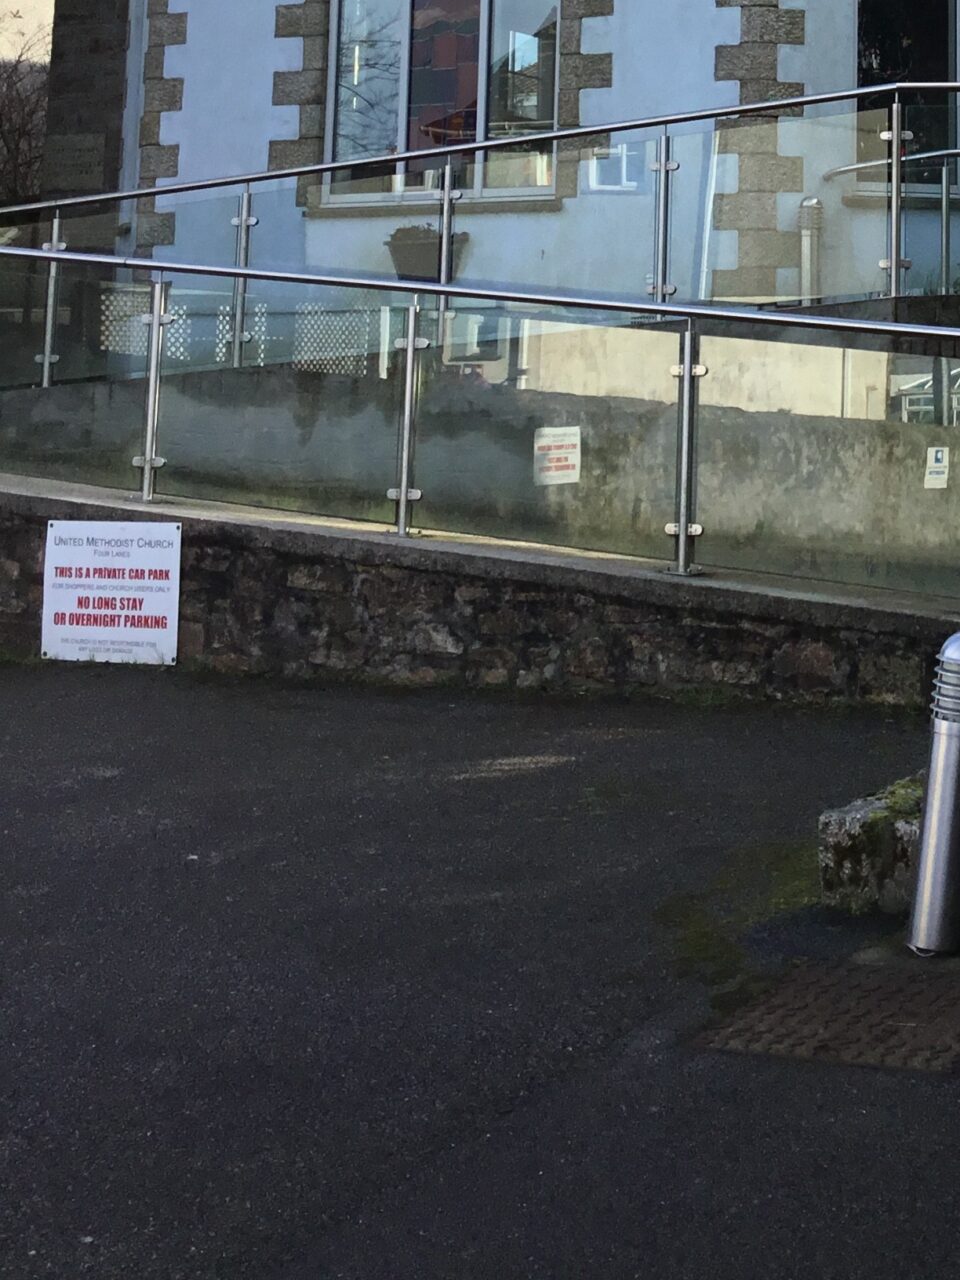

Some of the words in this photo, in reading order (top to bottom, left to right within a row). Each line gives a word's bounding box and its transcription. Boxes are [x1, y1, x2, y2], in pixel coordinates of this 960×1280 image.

[54, 536, 84, 547] UNITED
[86, 537, 134, 548] METHODIST
[137, 538, 174, 549] CHURCH
[54, 567, 73, 578] THIS
[75, 567, 83, 579] IS
[85, 568, 91, 579] A
[92, 567, 126, 580] PRIVATE
[129, 569, 145, 580] CAR
[148, 569, 170, 581] PARK
[77, 596, 90, 610] NO
[92, 596, 117, 610] LONG
[119, 597, 144, 611] STAY
[53, 612, 66, 626] OR
[68, 613, 122, 628] OVERNIGHT
[124, 614, 168, 629] PARKING
